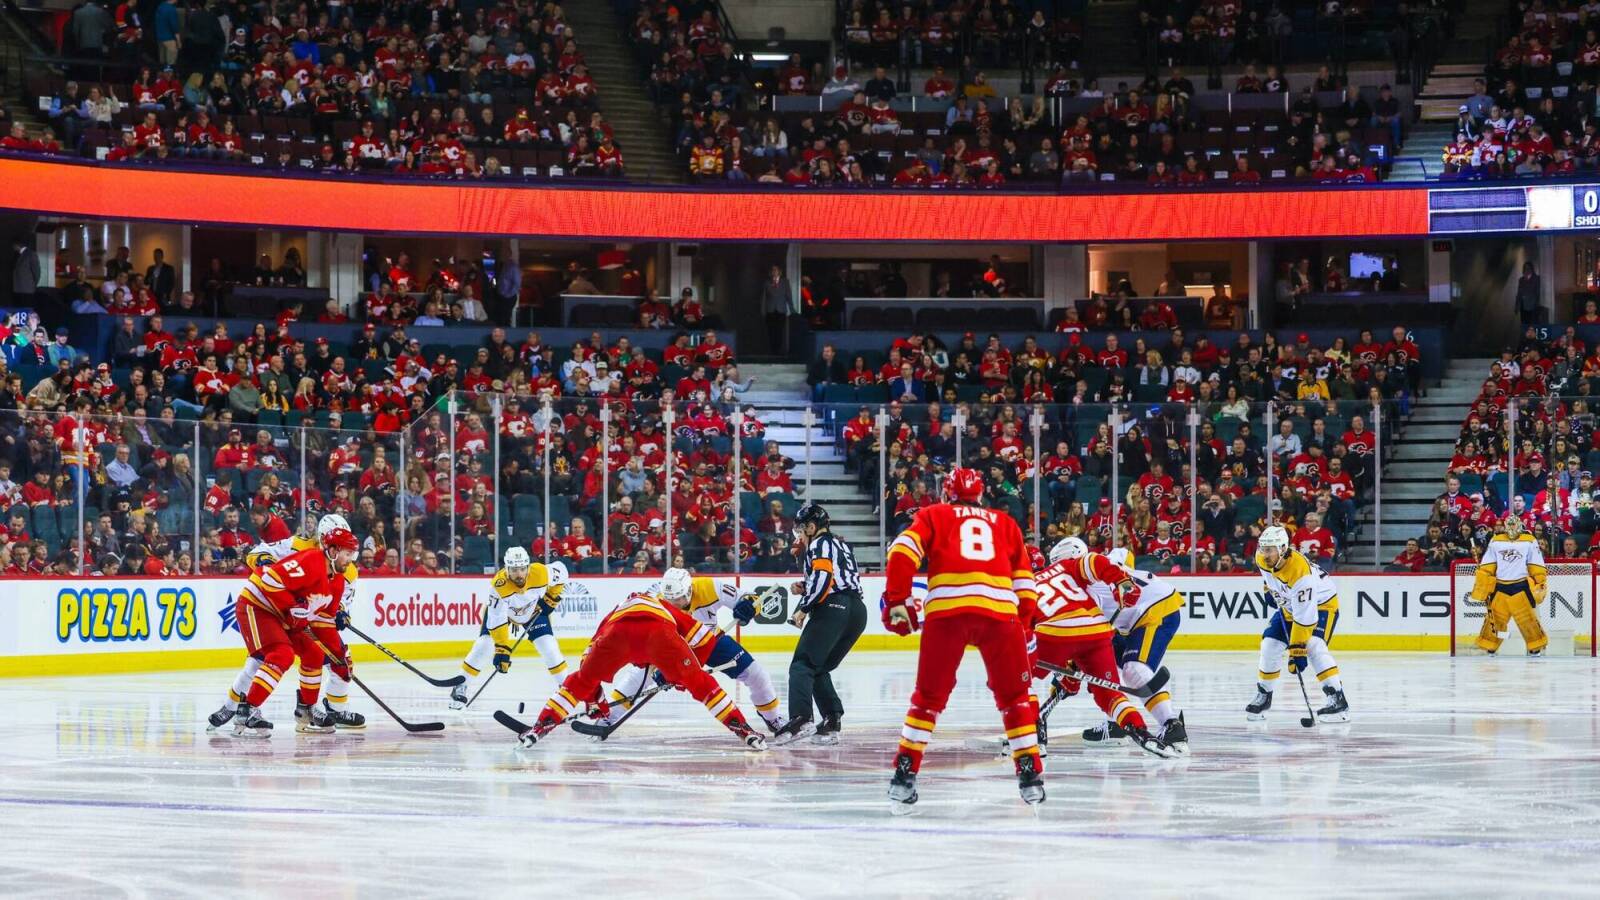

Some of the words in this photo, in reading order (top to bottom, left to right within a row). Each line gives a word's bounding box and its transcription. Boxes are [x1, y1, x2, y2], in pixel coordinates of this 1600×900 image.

[1583, 190, 1598, 213] 0
[1535, 327, 1548, 340] 15
[953, 506, 997, 524] TANEV
[960, 518, 995, 561] 8
[282, 559, 305, 578] 87
[1036, 573, 1089, 618] 20
[1297, 587, 1314, 603] 27
[1356, 590, 1584, 619] NISSN
[57, 588, 150, 643] PIZZA
[157, 587, 197, 642] 73
[374, 592, 483, 628] Scotiabank
